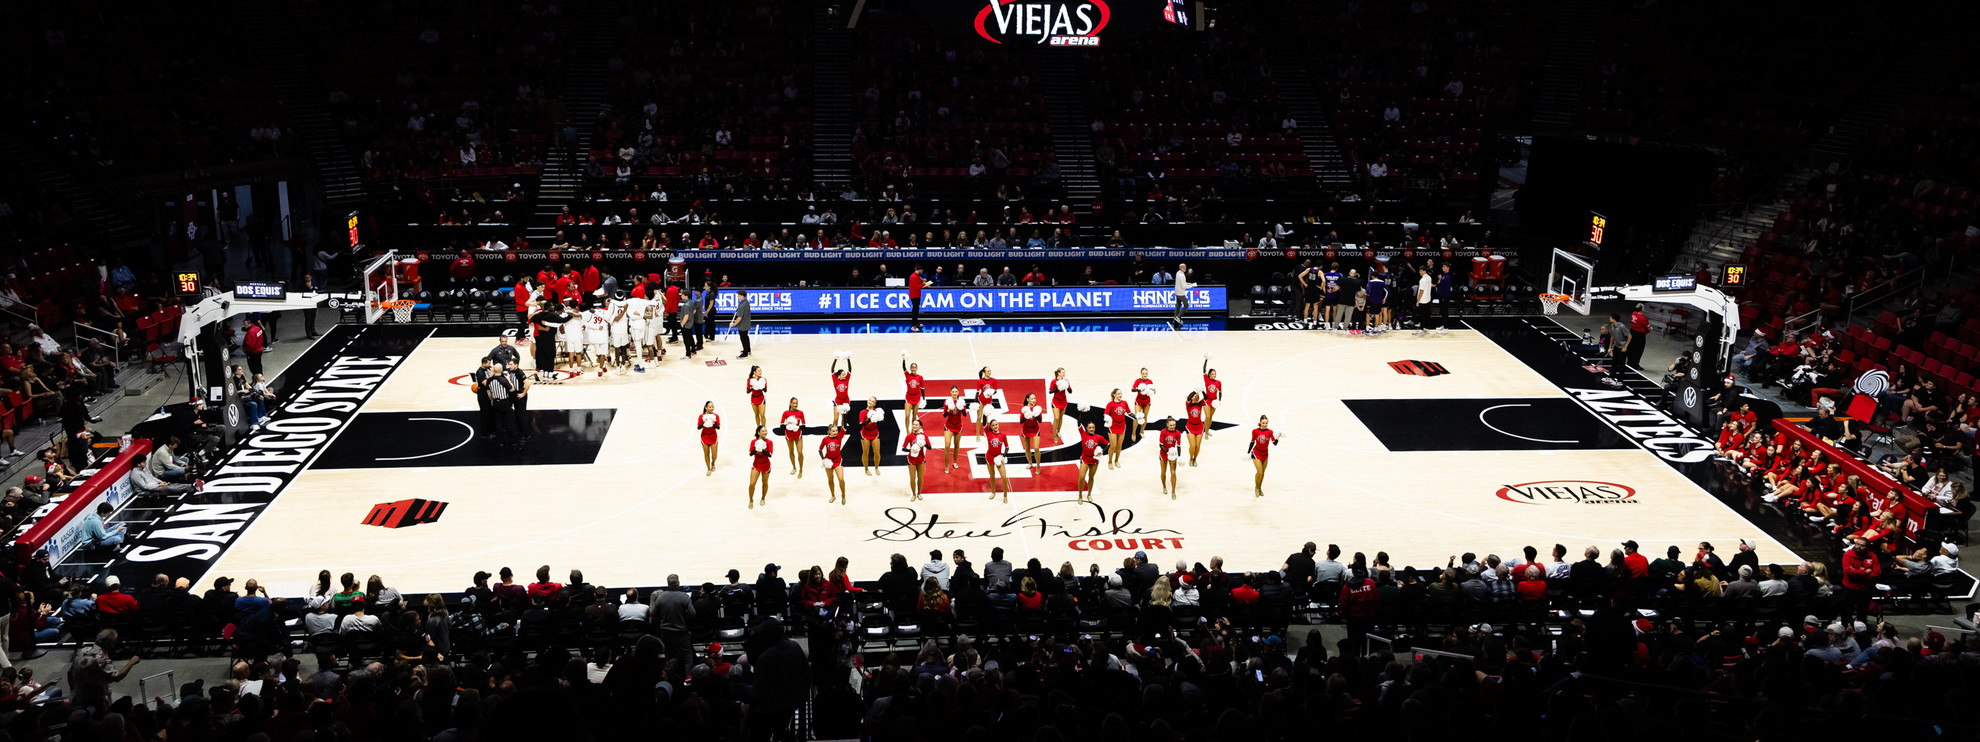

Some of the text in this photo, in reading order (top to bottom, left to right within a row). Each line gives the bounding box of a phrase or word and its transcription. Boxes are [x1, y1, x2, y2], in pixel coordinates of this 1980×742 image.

[990, 0, 1093, 44] VIEJAS
[1050, 35, 1100, 46] arena
[1590, 225, 1603, 245] 30
[179, 273, 197, 281] 10:39
[1727, 274, 1739, 284] 30
[181, 281, 195, 292] 30
[1656, 279, 1694, 288] DOS EQUIS
[236, 285, 281, 296] DOS EQUIS
[819, 291, 1113, 309] #1 ICE CRAM ON THE PLANET
[593, 316, 603, 324] 39
[1563, 387, 1717, 463] AZTECS
[125, 355, 403, 562] SAN DIEGO STATE
[1502, 484, 1621, 503] VIEJAS
[1067, 537, 1185, 551] COURT
